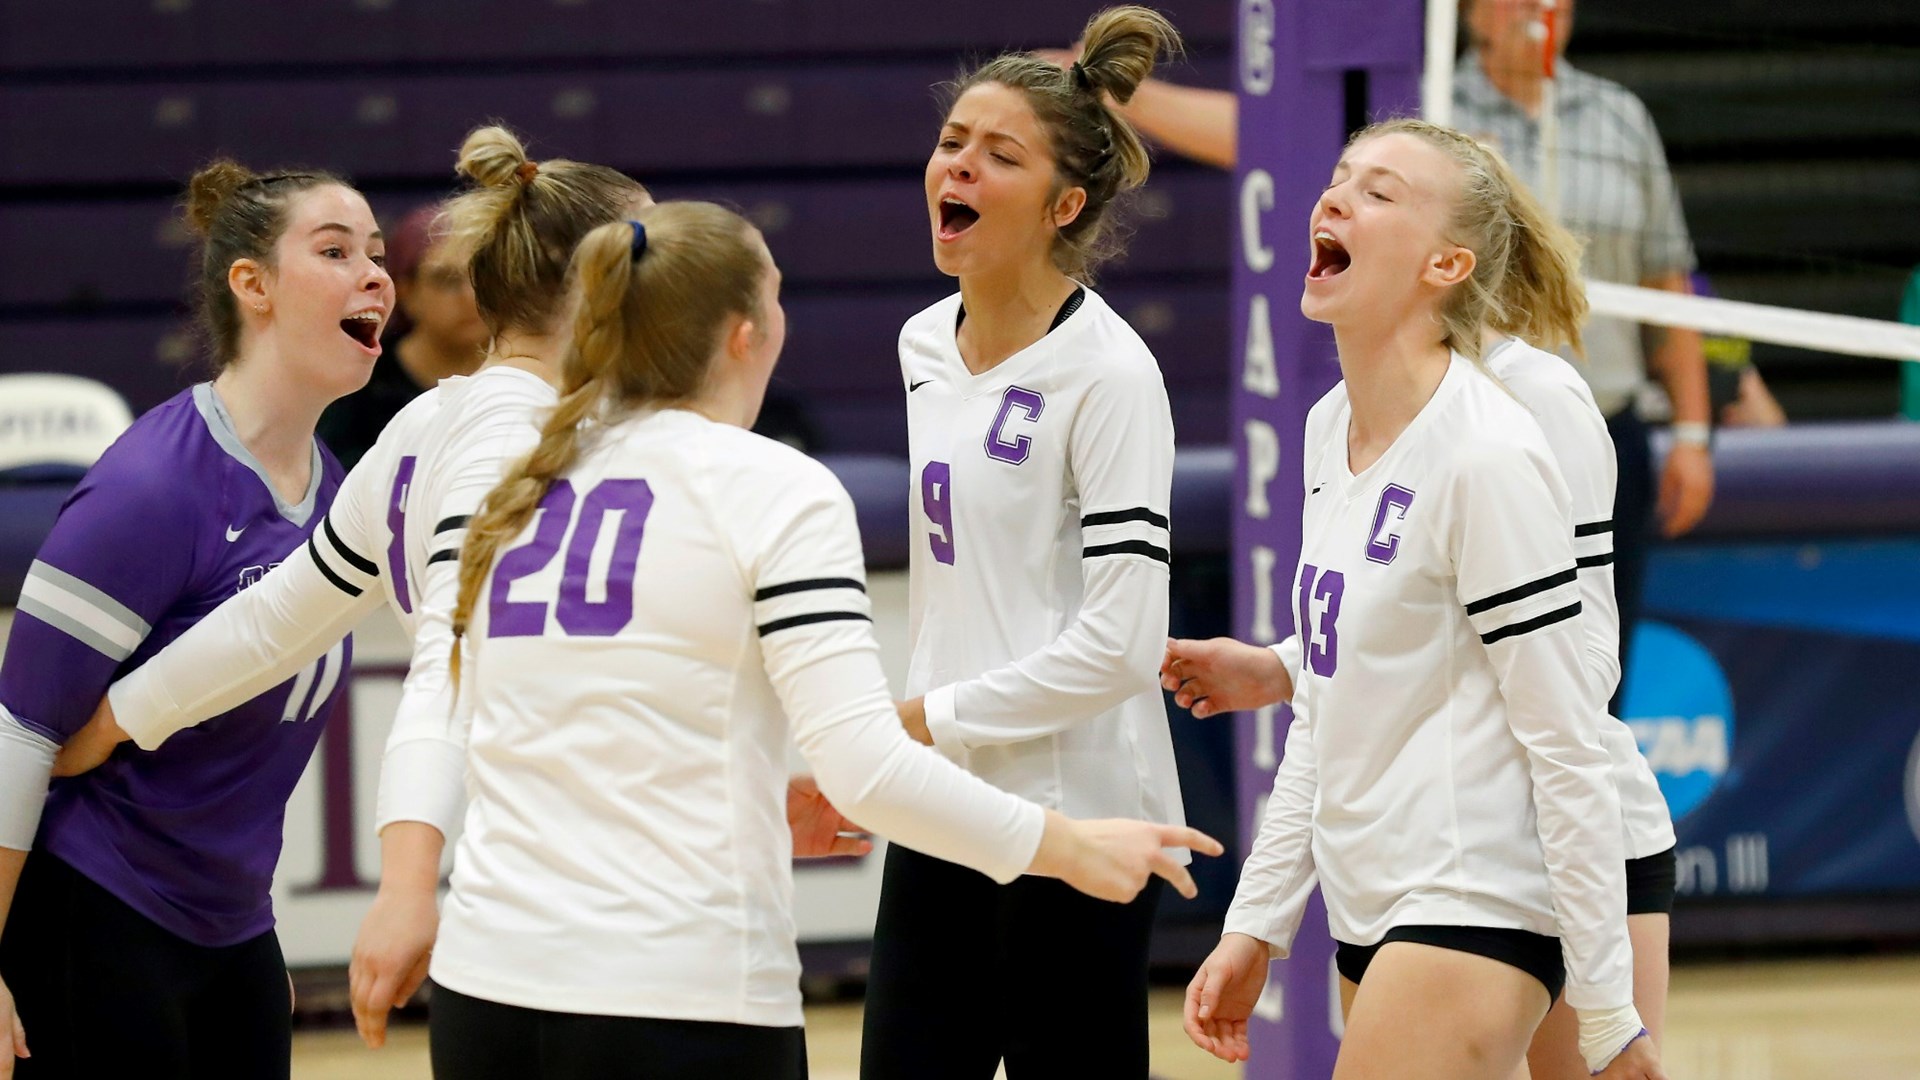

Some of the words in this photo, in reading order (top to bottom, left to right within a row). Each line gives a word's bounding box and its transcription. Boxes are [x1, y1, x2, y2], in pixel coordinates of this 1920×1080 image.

[984, 385, 1045, 466] C
[488, 478, 654, 639] 20
[921, 461, 955, 566] 9
[1364, 483, 1416, 565] C
[1299, 563, 1345, 678] 13
